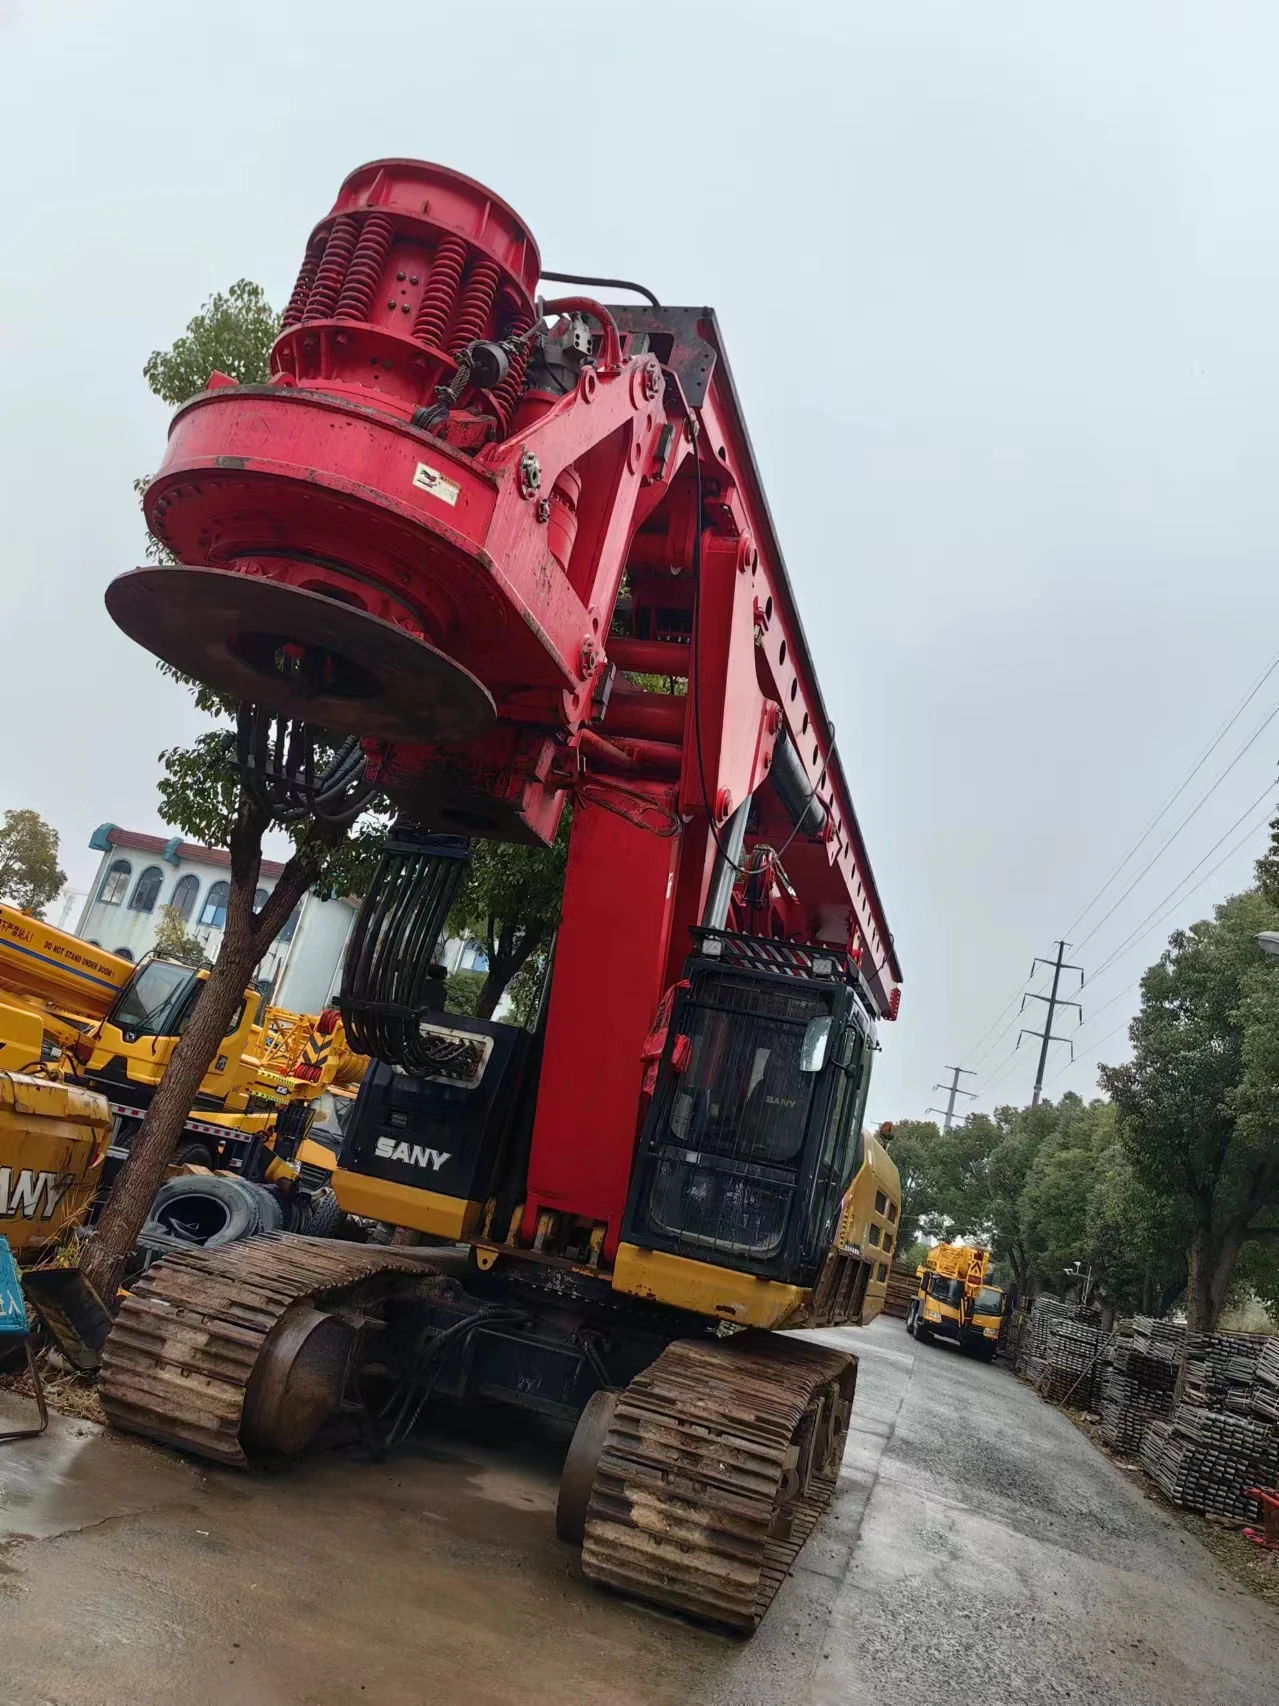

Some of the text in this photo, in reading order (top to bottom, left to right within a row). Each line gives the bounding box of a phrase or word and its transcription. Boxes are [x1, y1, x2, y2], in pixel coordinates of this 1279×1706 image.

[44, 940, 53, 950] DO
[53, 944, 65, 956] NOT
[65, 949, 82, 963] STAND
[81, 957, 99, 971] UNDER
[374, 1136, 452, 1171] SANY
